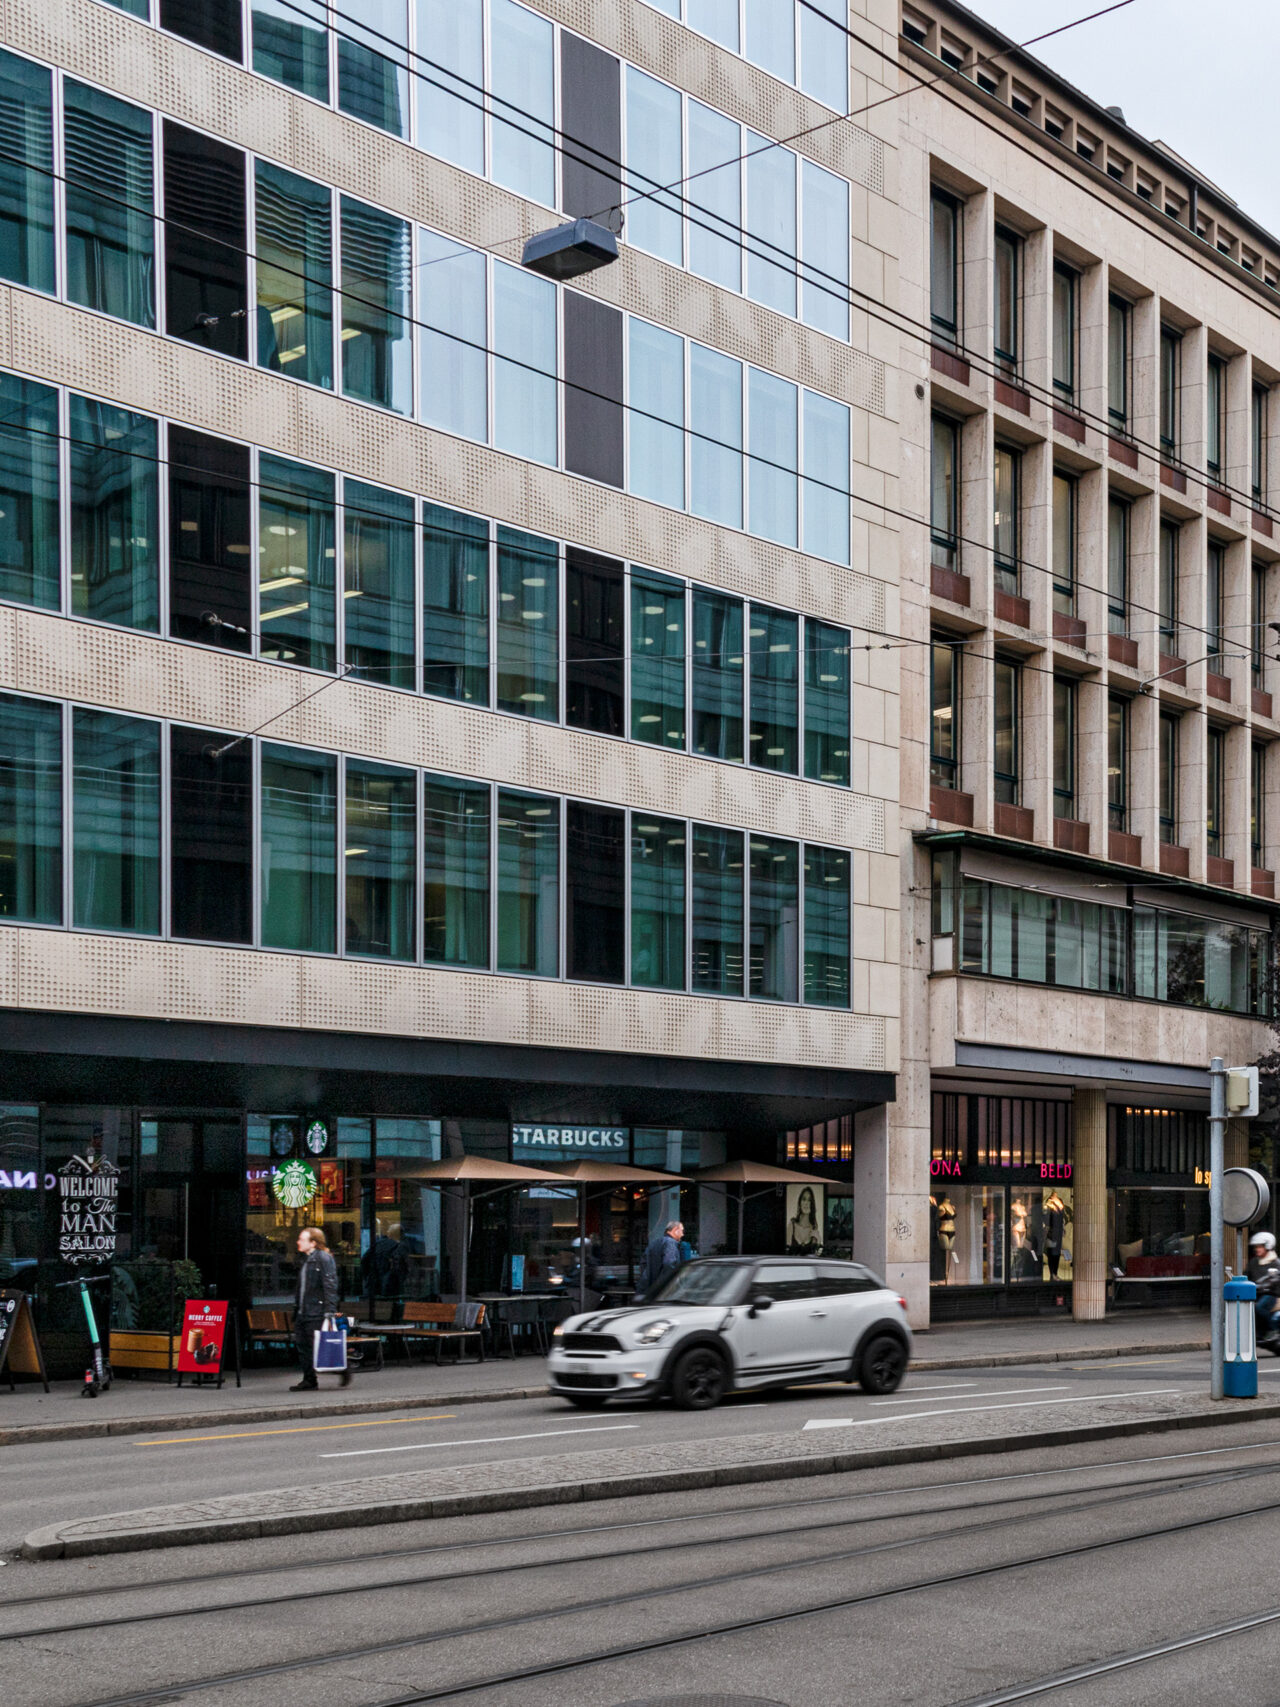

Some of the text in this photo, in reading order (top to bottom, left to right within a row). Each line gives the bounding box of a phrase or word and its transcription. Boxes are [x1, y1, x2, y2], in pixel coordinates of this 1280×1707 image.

[513, 1127, 624, 1147] STARBUCKS
[930, 1160, 962, 1176] ONA
[1040, 1163, 1072, 1178] BELD
[60, 1177, 118, 1197] WELCOME
[62, 1198, 116, 1214] to The
[60, 1214, 117, 1233] MAN
[59, 1235, 117, 1250] SALON
